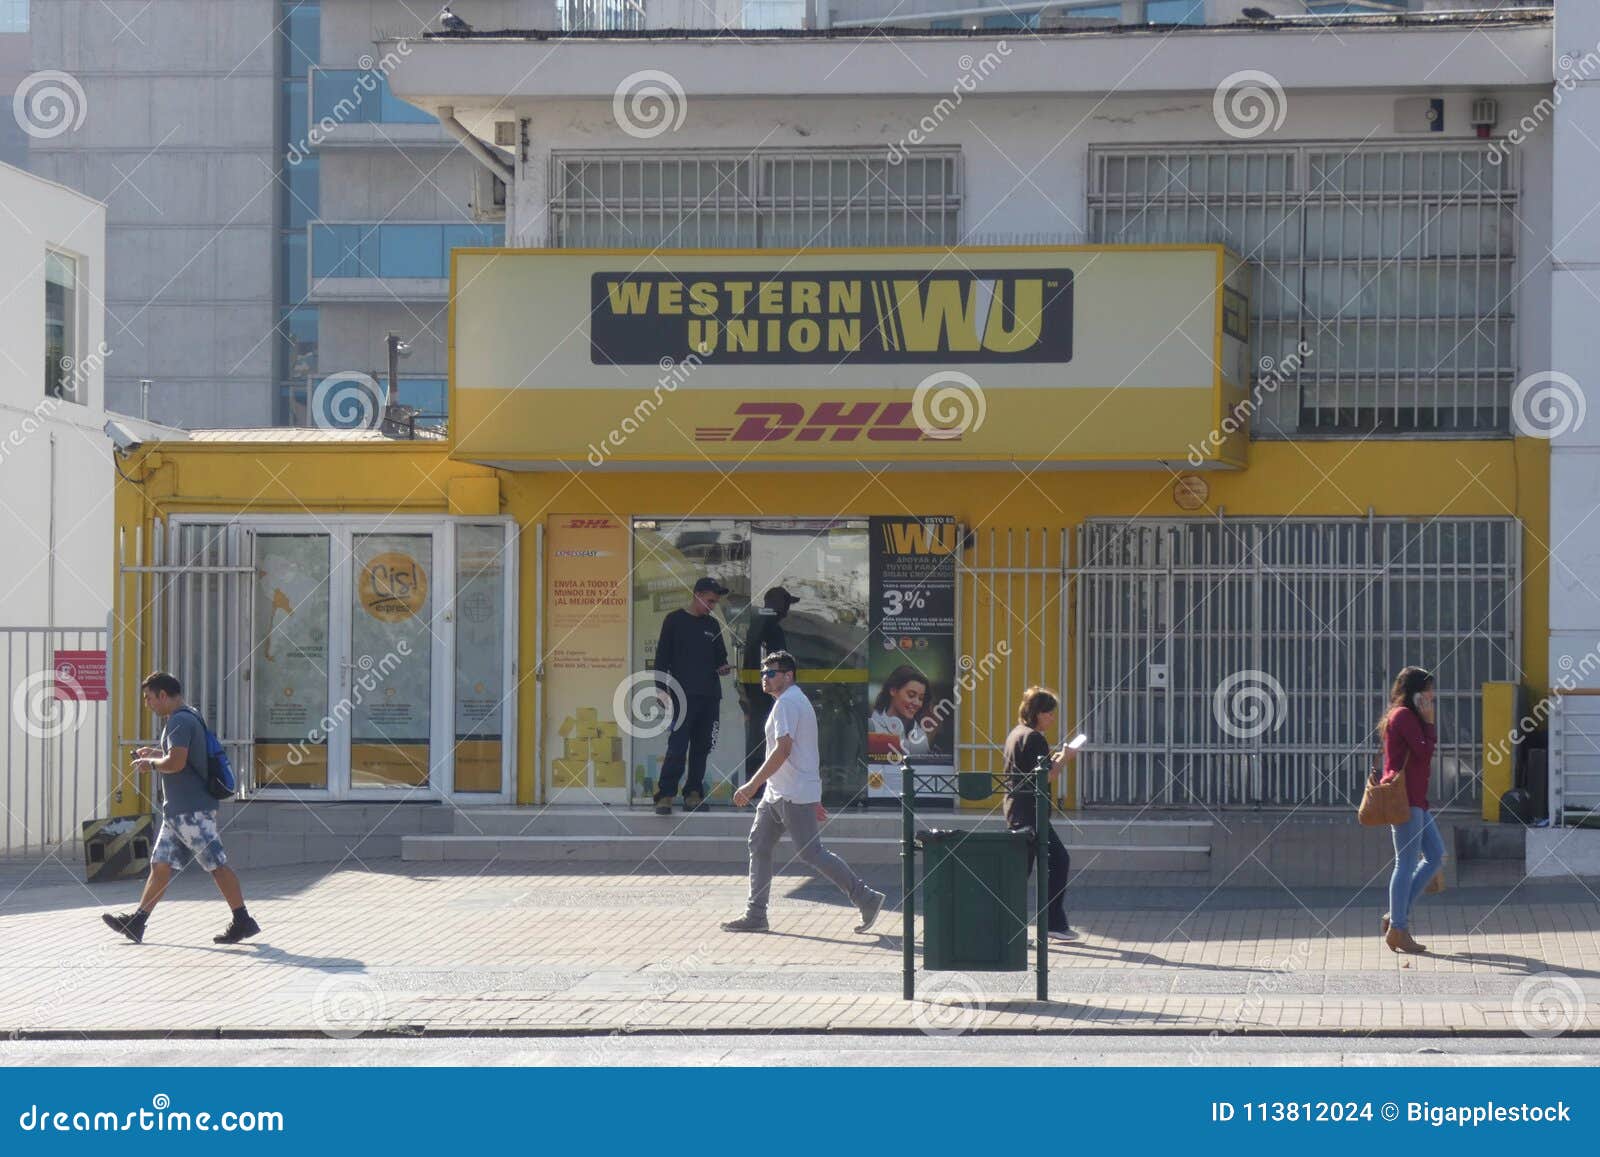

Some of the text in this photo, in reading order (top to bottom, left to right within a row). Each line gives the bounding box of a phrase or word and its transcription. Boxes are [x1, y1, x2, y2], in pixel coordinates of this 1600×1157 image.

[606, 280, 862, 315] WESTERN
[893, 278, 1044, 353] WU
[687, 318, 862, 353] UNION
[729, 402, 926, 441] DHL
[566, 519, 611, 529] DHL
[890, 523, 956, 555] WU
